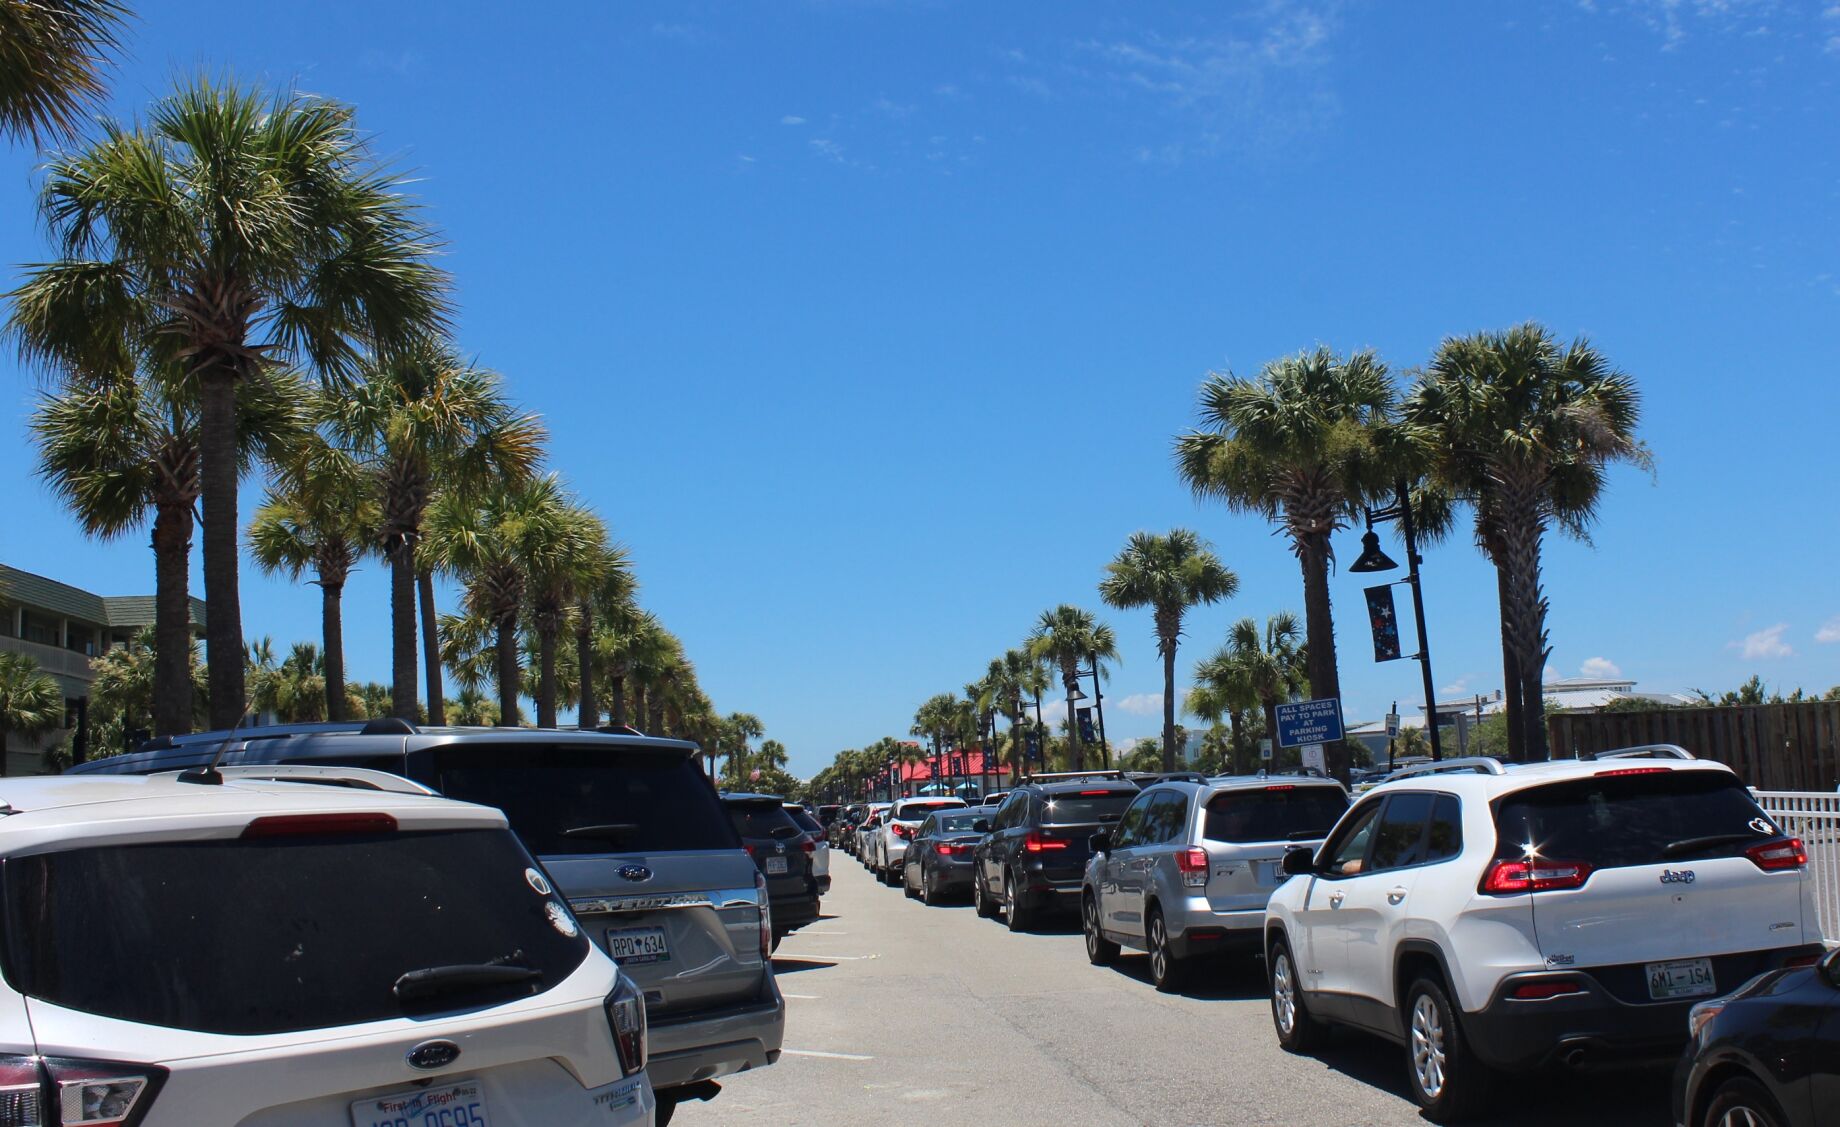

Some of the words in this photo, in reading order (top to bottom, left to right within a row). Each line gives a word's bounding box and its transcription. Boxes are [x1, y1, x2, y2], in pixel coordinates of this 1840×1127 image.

[1281, 706, 1298, 714] ALL
[1300, 701, 1333, 712] SPACES
[1280, 713, 1297, 722] PAY
[1312, 709, 1335, 718] PARK
[1289, 725, 1328, 736] PARKING
[1297, 734, 1325, 743] KIOSK
[1660, 869, 1696, 884] Jeep
[613, 938, 636, 957] RPQ
[644, 935, 666, 952] 634
[383, 1101, 407, 1113] First
[427, 1092, 456, 1105] Flight
